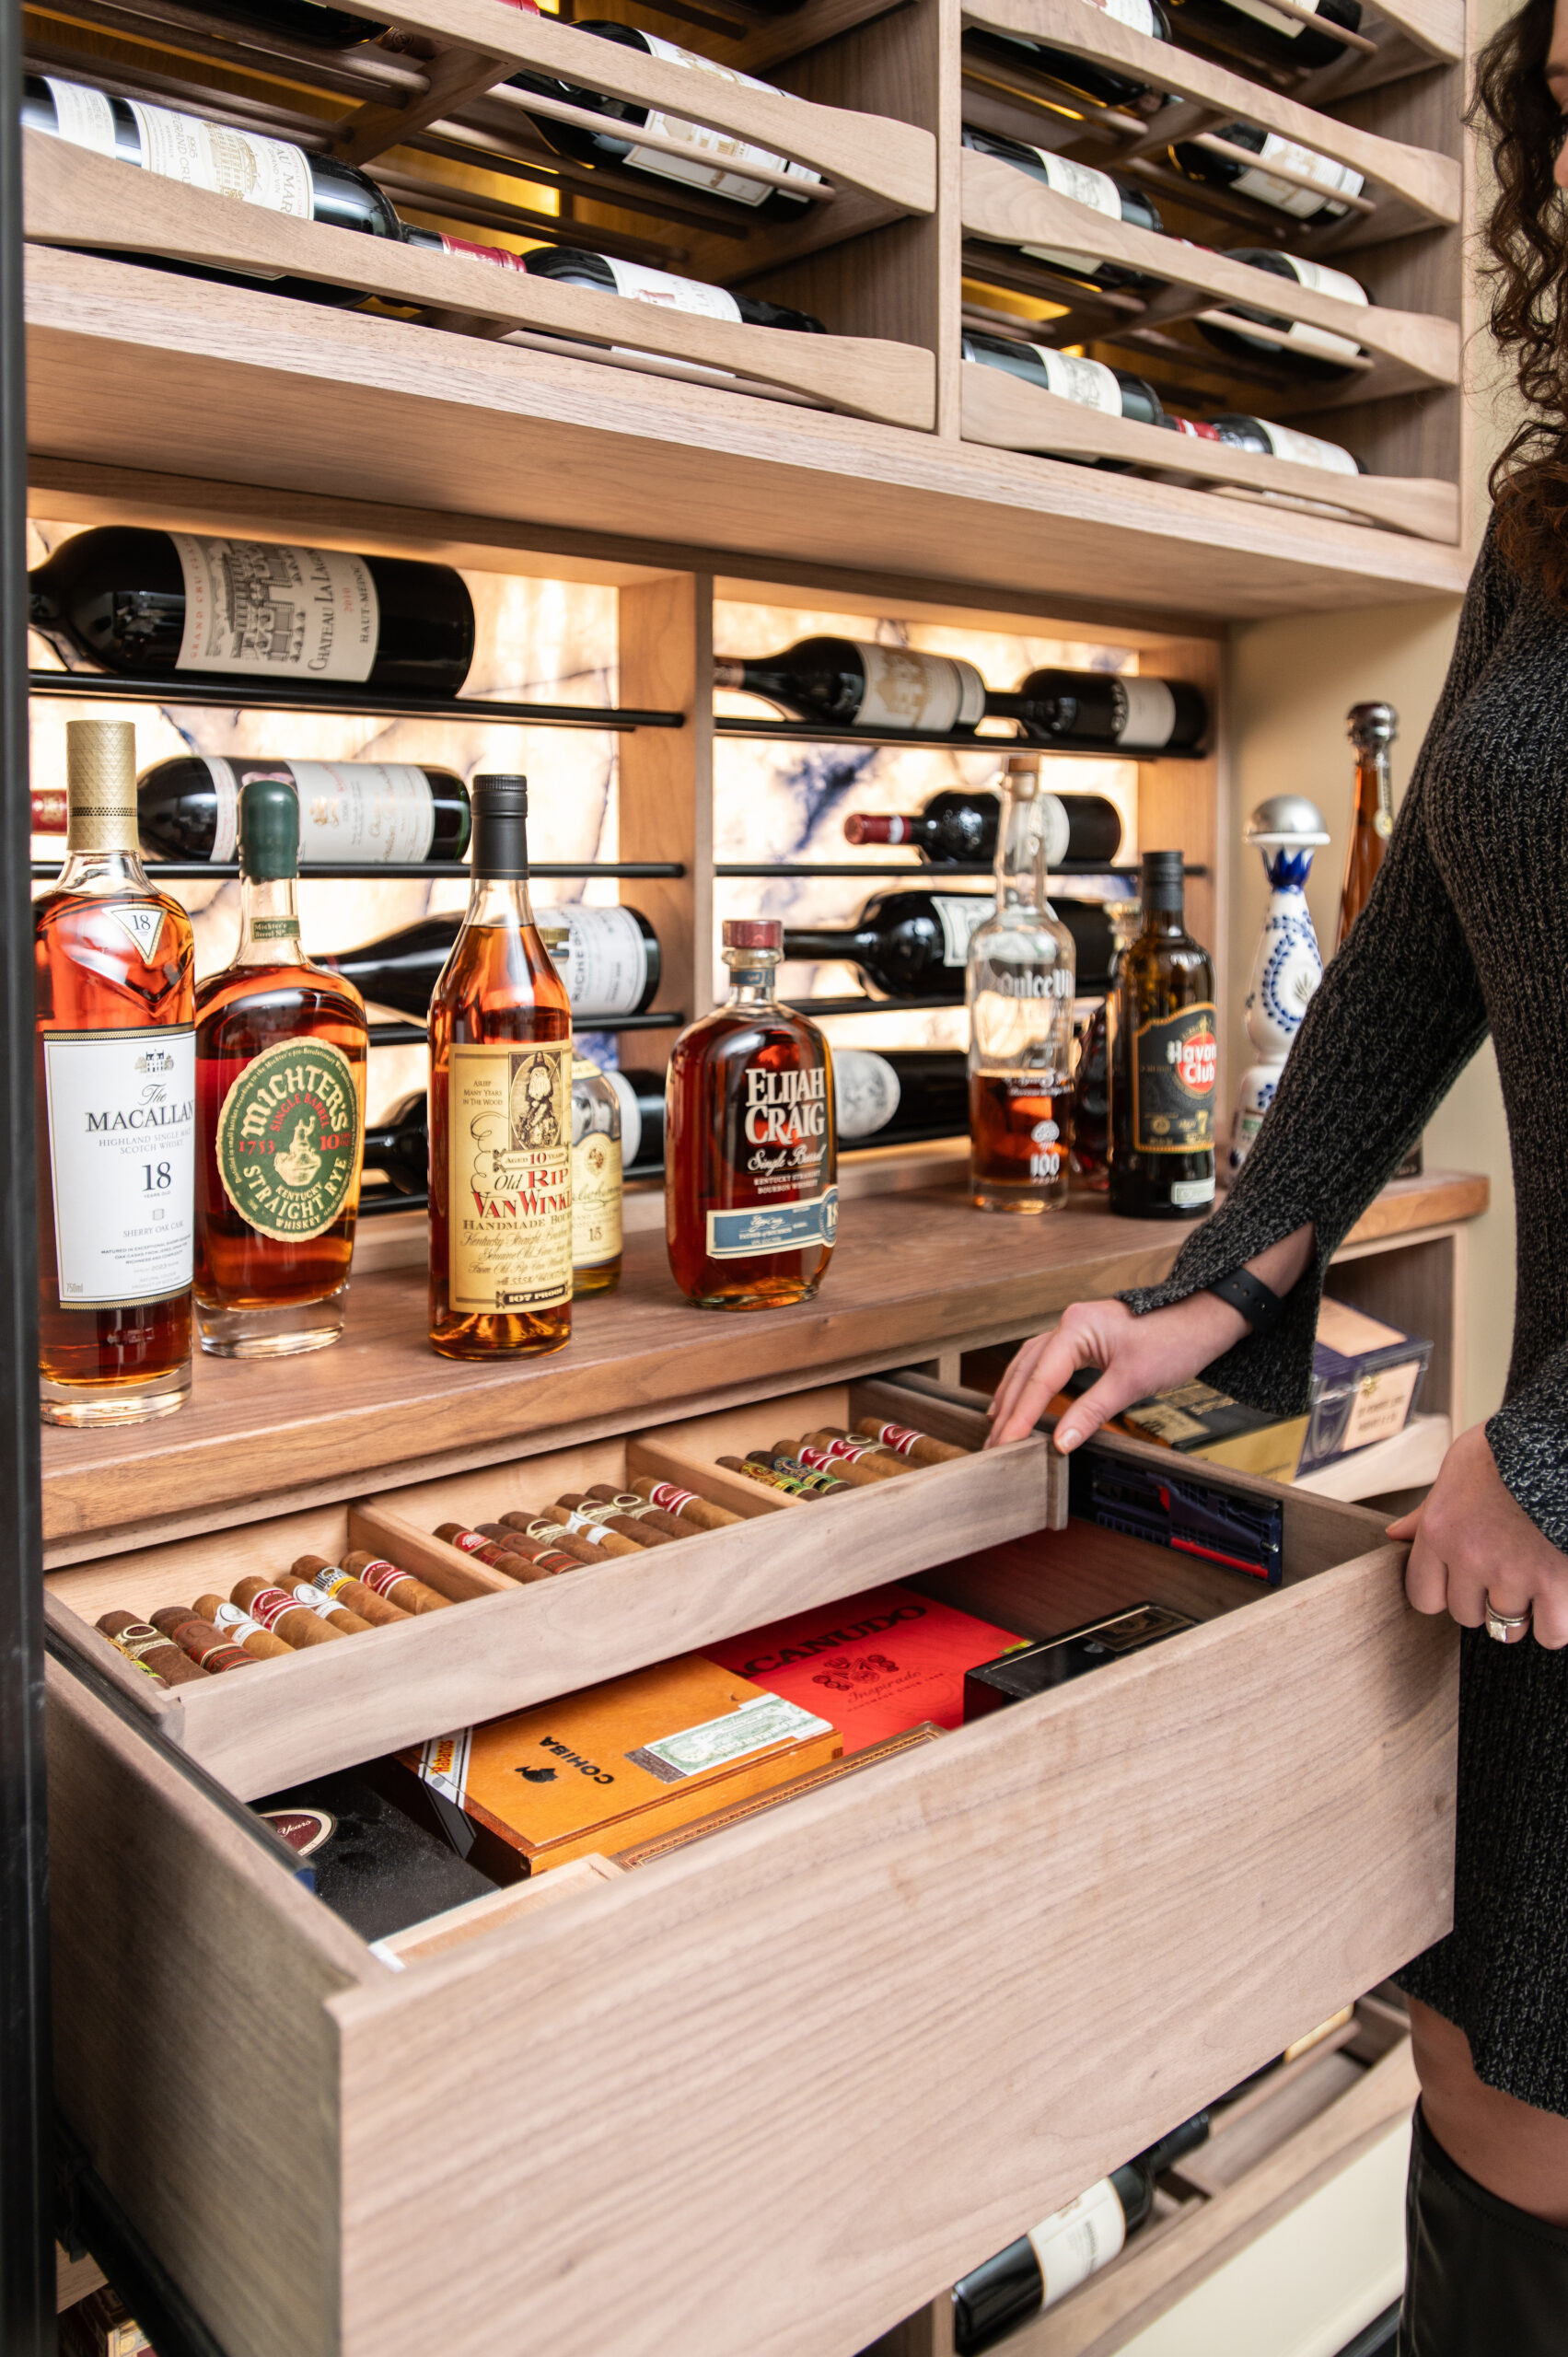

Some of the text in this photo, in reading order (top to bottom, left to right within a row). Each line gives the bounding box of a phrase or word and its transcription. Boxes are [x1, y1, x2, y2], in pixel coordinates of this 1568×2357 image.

[193, 576, 203, 603] CRU
[314, 584, 334, 605] LA
[190, 610, 203, 659] GRAND
[132, 914, 151, 931] 18
[1167, 1039, 1216, 1063] Havan
[1184, 1062, 1214, 1084] Club
[137, 1084, 166, 1105] The
[270, 1093, 301, 1132] SINGLE
[304, 1092, 330, 1130] BARREL
[1195, 1110, 1210, 1133] 7
[745, 1103, 826, 1145] CRAIG
[99, 1135, 151, 1147] HIGHLAND
[154, 1131, 179, 1141] SINGLE
[120, 1144, 157, 1155] SCOTCH
[238, 1140, 275, 1155] 1753
[319, 1134, 340, 1151] 10
[529, 1152, 547, 1165] 10
[748, 1148, 786, 1176] Single
[1030, 1154, 1060, 1177] 100
[142, 1161, 171, 1191] 18
[323, 1156, 347, 1196] RYE
[494, 1174, 523, 1190] Old
[243, 1165, 325, 1220] STRAIGHT
[275, 1181, 323, 1202] KENTUCKY
[516, 1189, 572, 1216] WINKL
[122, 1226, 154, 1237] SHERRY
[275, 1214, 321, 1230] WHISKEY
[463, 1219, 545, 1230] HANDMADE
[589, 1226, 603, 1242] 15
[508, 1285, 564, 1304] 107 PROOF
[730, 1606, 927, 1679] CANUDO
[847, 1671, 920, 1703] Inspirado
[540, 1736, 614, 1784] COHIBA
[277, 1820, 312, 1838] Years
